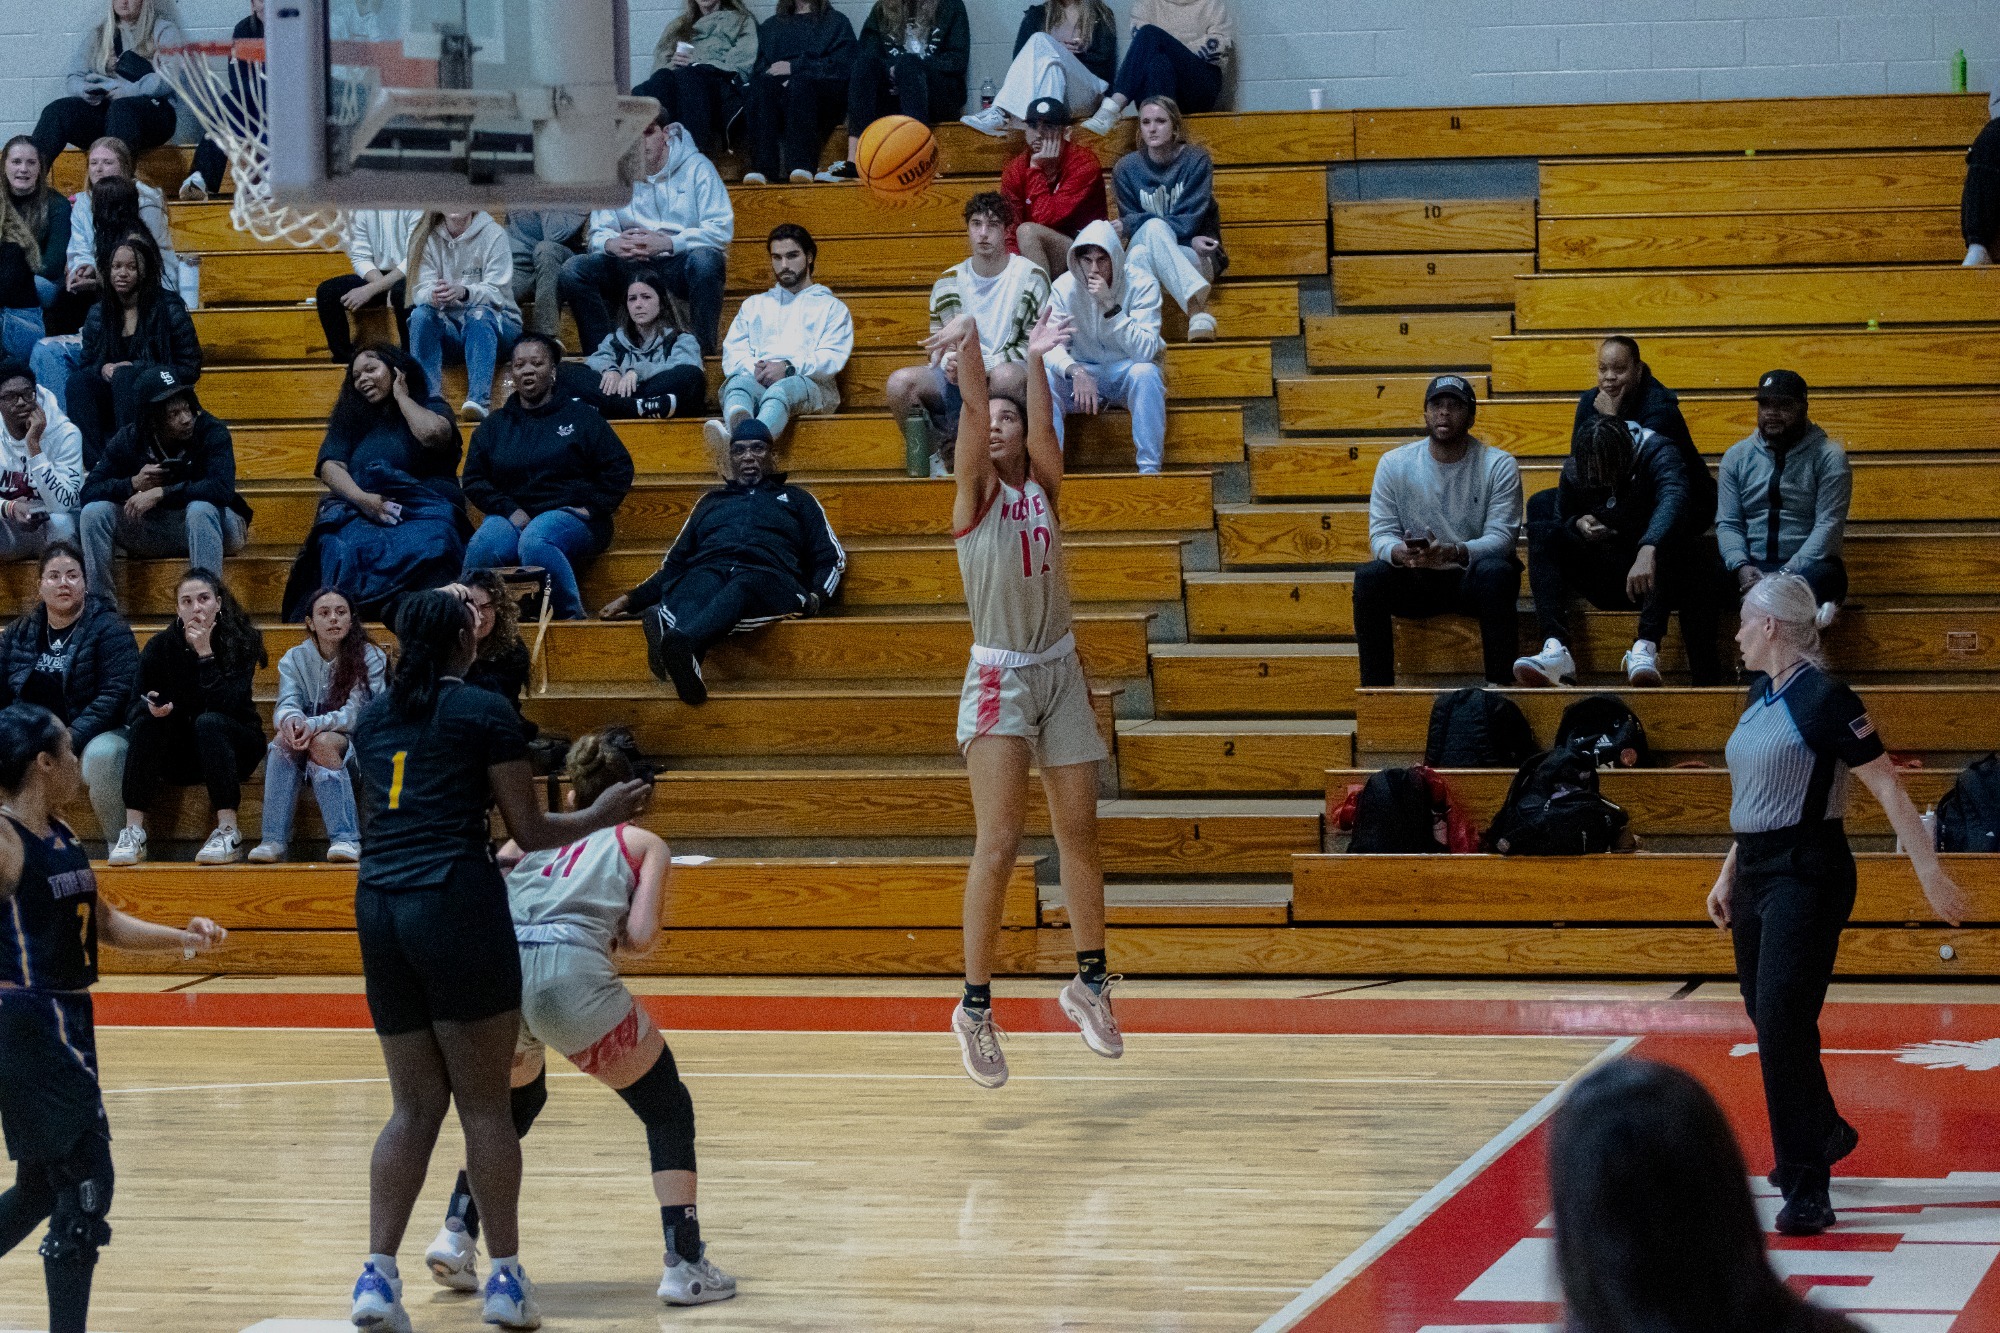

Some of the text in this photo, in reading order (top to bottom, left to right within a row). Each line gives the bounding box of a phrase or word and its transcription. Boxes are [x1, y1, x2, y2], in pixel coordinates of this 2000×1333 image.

[1450, 116, 1461, 130] 11
[1424, 205, 1441, 218] 10
[1426, 262, 1437, 275] 9
[1400, 322, 1409, 336] 8
[1376, 385, 1386, 399] 7
[1348, 446, 1358, 460] 6
[1321, 515, 1331, 530] 5
[1018, 526, 1051, 577] 12
[1290, 586, 1300, 602] 4
[1258, 661, 1269, 677] 3
[1224, 741, 1235, 757] 2
[388, 751, 408, 809] 1
[1194, 823, 1201, 840] 1
[541, 840, 589, 878] 11
